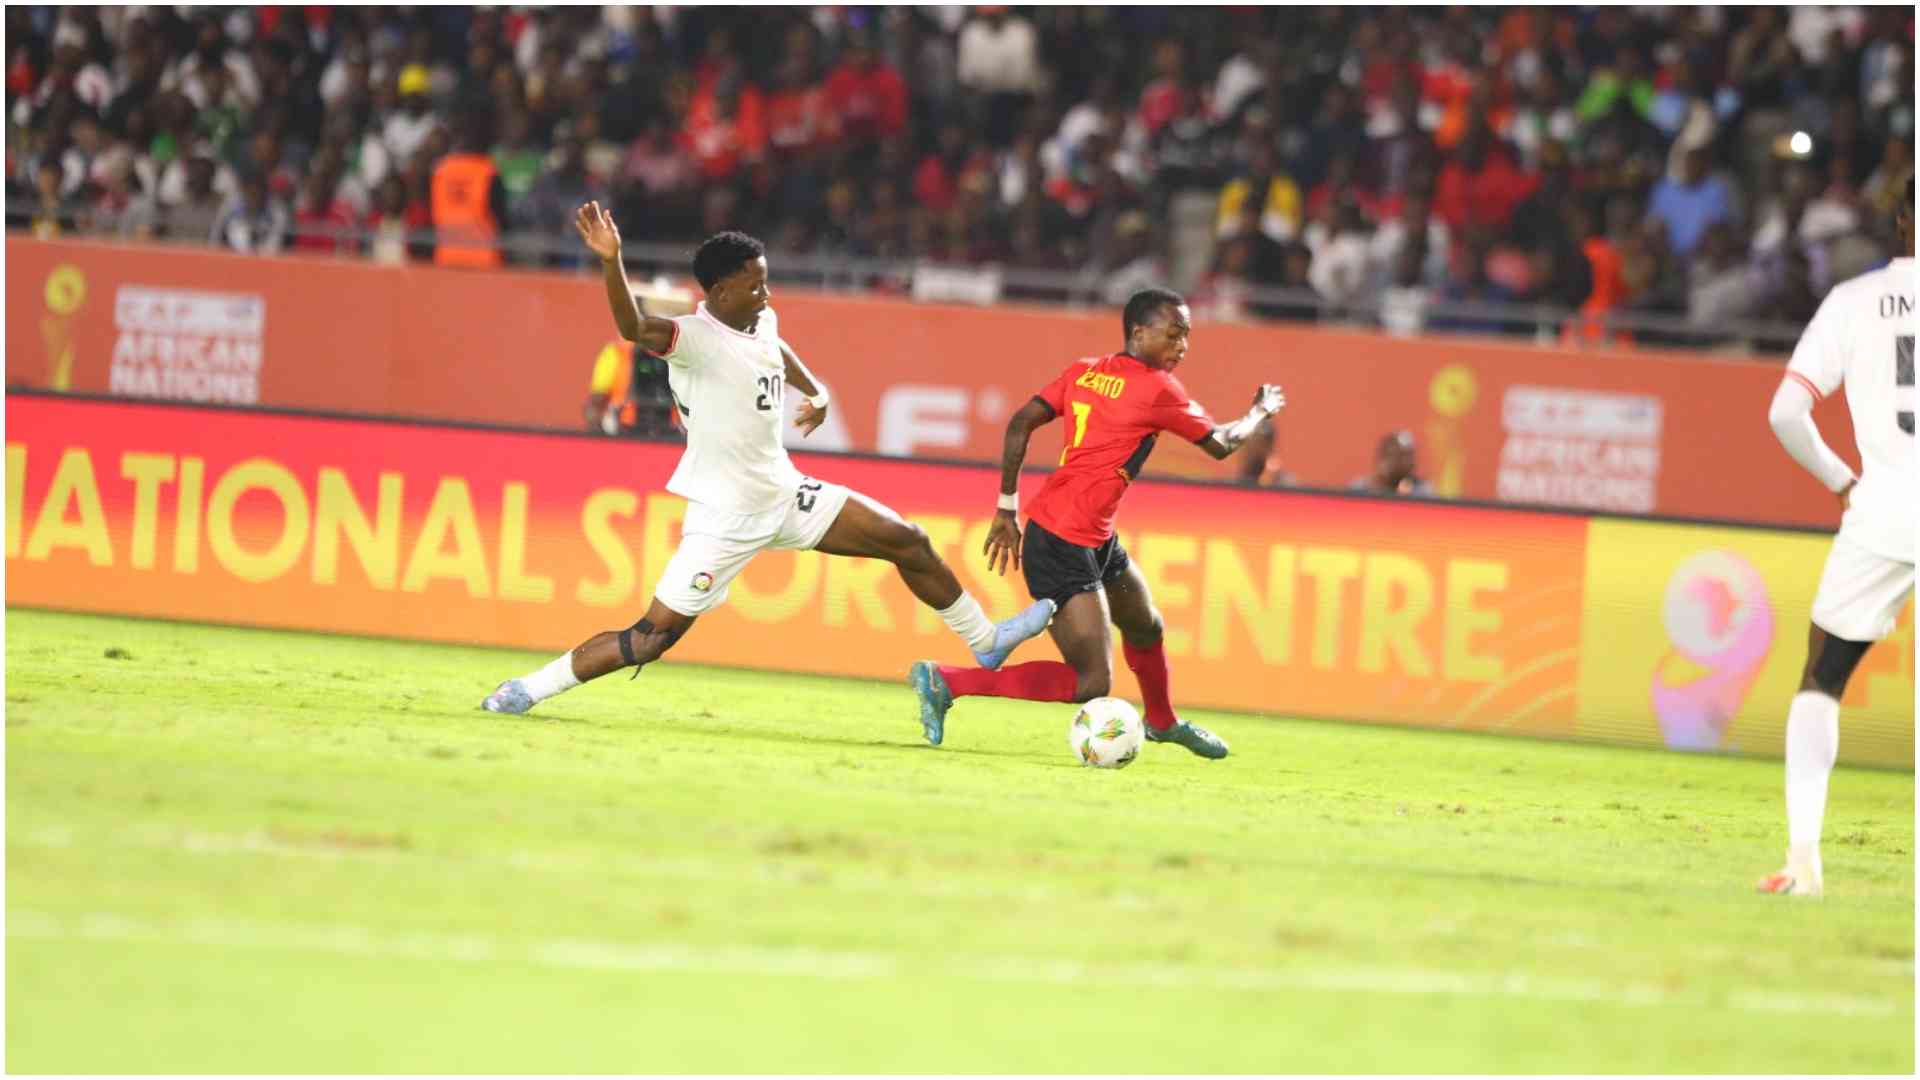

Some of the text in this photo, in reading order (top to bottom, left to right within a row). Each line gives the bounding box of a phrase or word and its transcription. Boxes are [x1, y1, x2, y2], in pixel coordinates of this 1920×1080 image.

[756, 374, 782, 411] 20
[1071, 400, 1091, 448] 7
[1108, 526, 1508, 684] ENTRE
